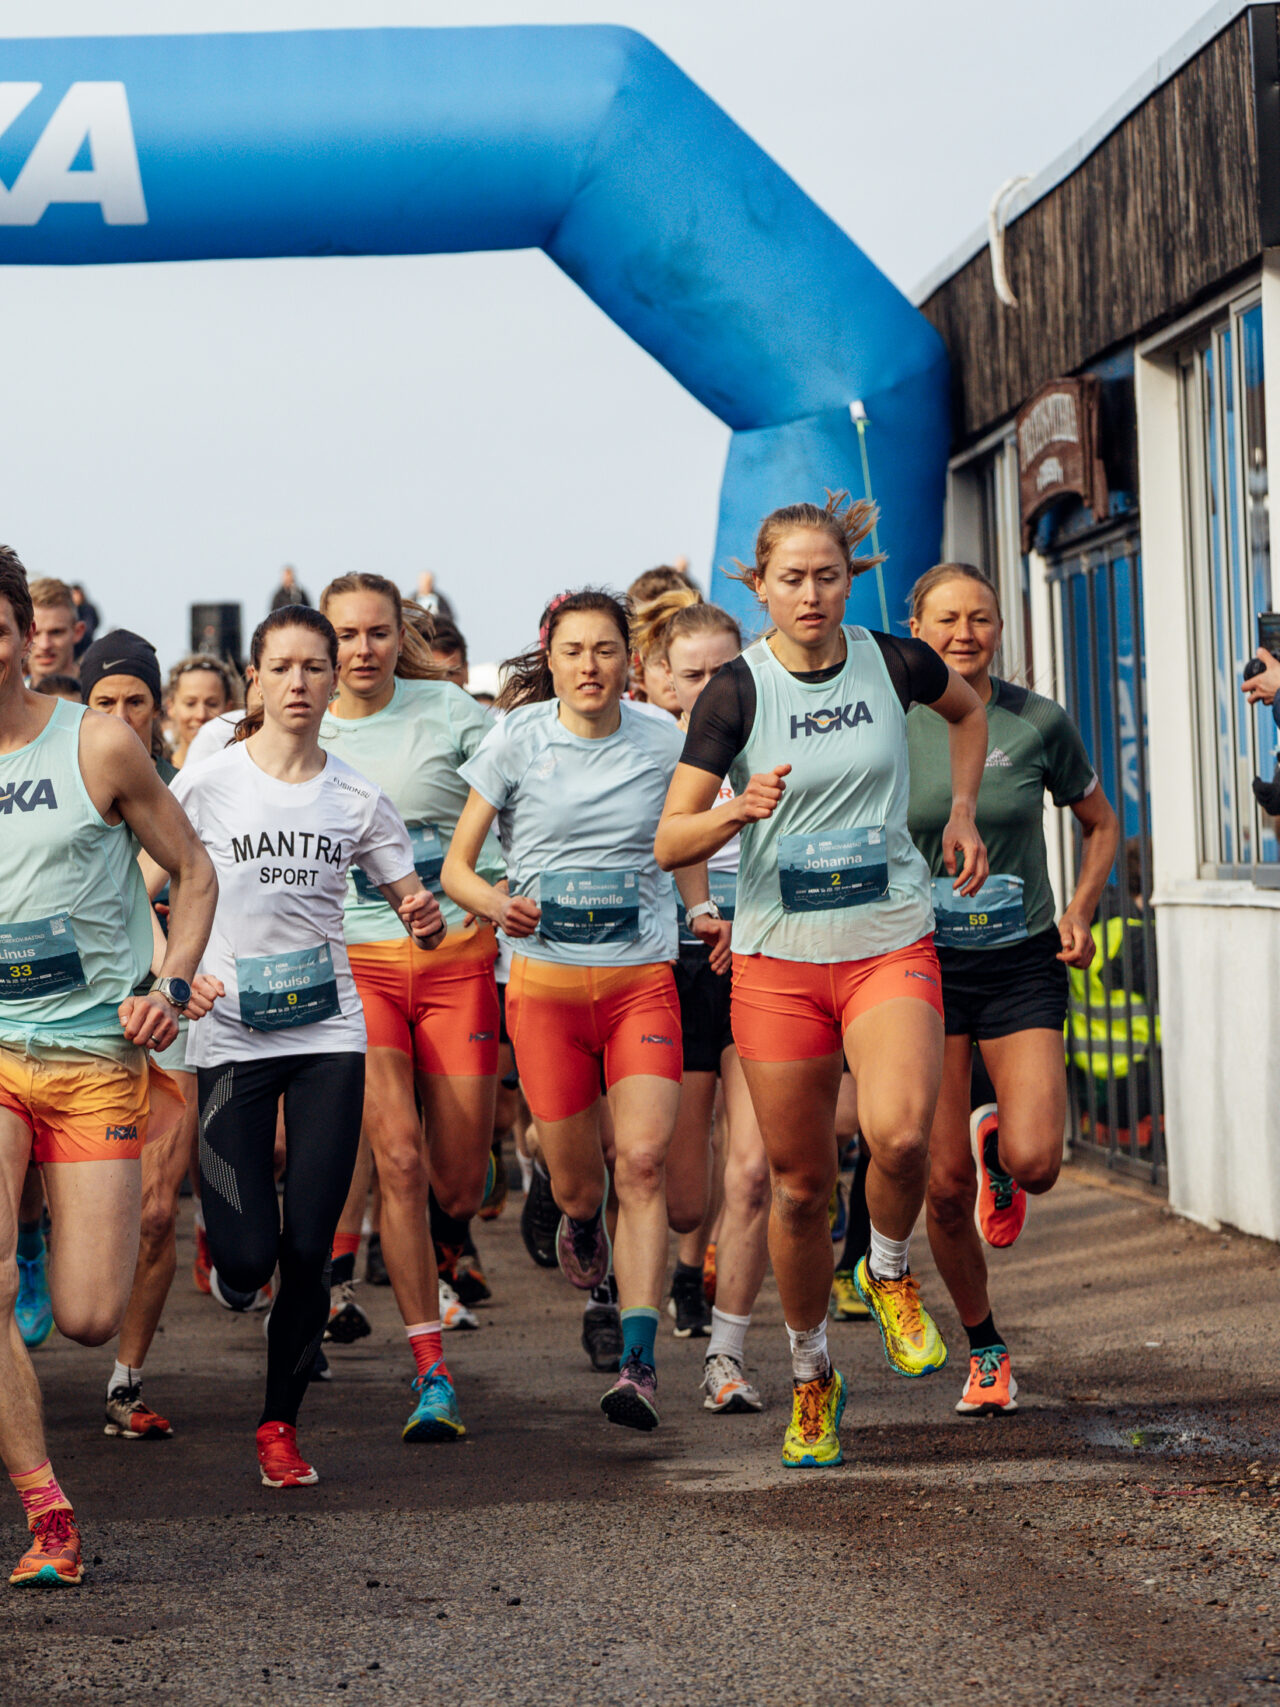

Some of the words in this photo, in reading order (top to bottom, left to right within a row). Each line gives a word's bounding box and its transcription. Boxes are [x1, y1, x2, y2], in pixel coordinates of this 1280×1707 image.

[790, 700, 874, 740] HOKA
[231, 831, 342, 870] MANTRA
[804, 854, 863, 870] Johanna
[259, 866, 319, 887] SPORT
[831, 873, 841, 886] 2
[557, 894, 577, 905] Ida
[579, 894, 624, 906] Amelie
[587, 911, 593, 922] 1
[968, 913, 988, 926] 59
[9, 964, 33, 978] 33
[268, 975, 311, 990] Louise
[287, 993, 298, 1005] 9
[105, 1125, 138, 1141] HOKA
